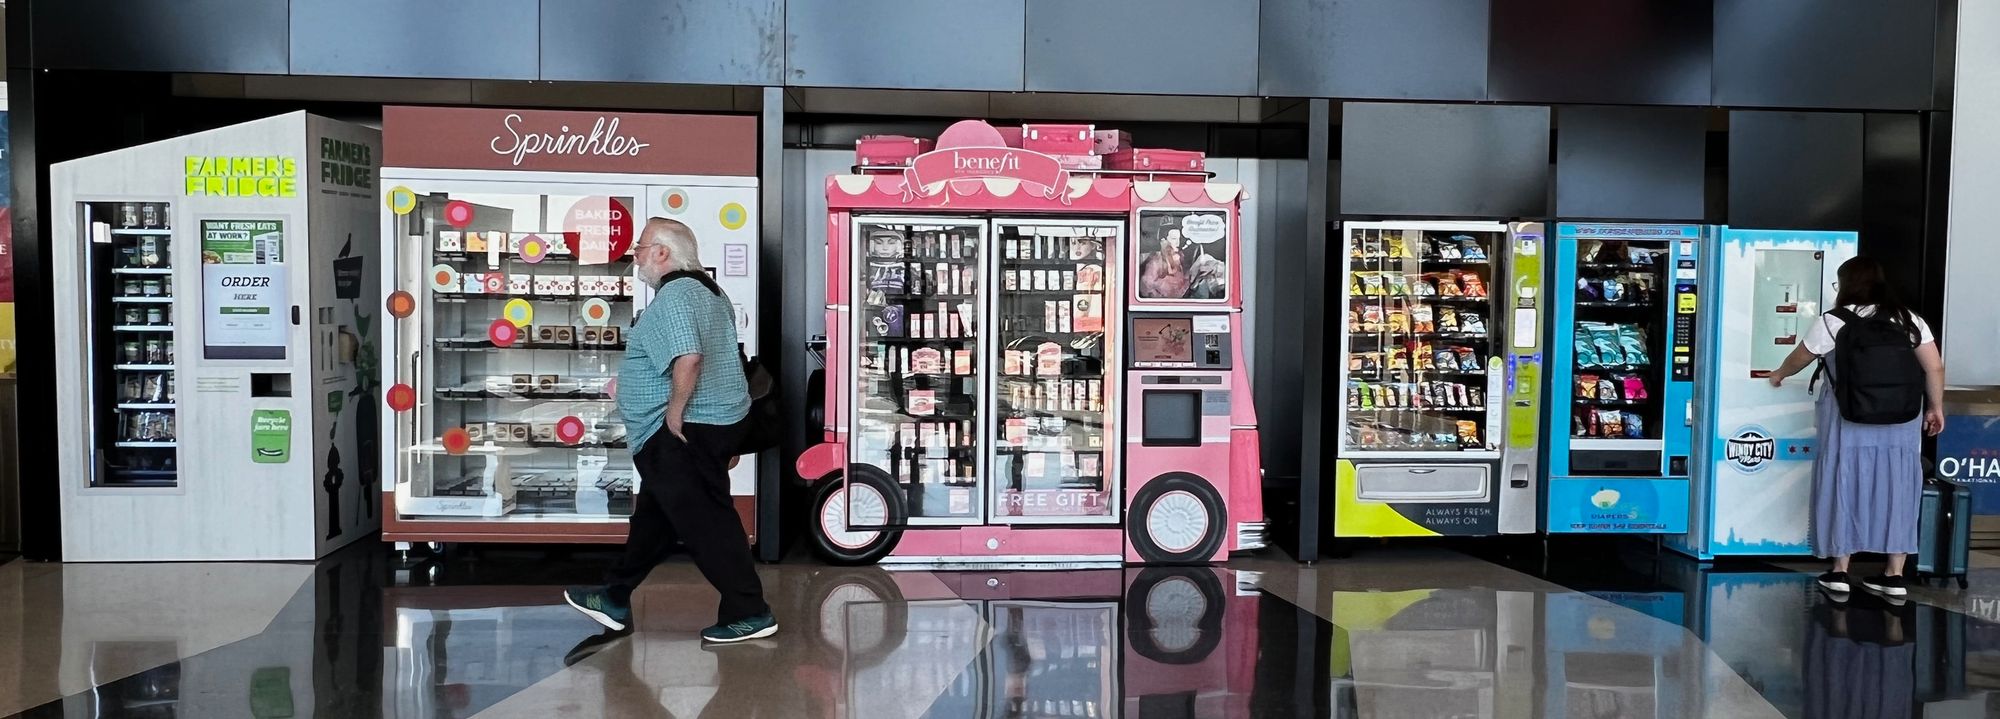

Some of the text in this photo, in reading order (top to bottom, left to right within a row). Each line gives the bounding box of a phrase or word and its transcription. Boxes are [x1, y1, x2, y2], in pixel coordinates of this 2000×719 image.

[491, 113, 650, 166] Sprinkles
[321, 137, 371, 166] FARMER'S
[185, 154, 297, 177] FARMER'S
[954, 151, 1021, 173] benefit
[321, 161, 371, 189] FRIDGE
[185, 176, 297, 197] FRIDGE
[575, 210, 622, 220] BAKED
[206, 222, 277, 230] WANT FRESH EATS
[575, 225, 621, 236] FRESH
[207, 232, 248, 240] AT WORK?
[582, 241, 618, 251] DAILY
[221, 276, 271, 288] ORDER
[233, 293, 258, 301] HERE
[1728, 441, 1773, 459] WINDY CITY
[998, 493, 1101, 507] FREE GIFT
[1426, 508, 1460, 516] ALWAYS
[1426, 516, 1478, 525] ALWAYS ON
